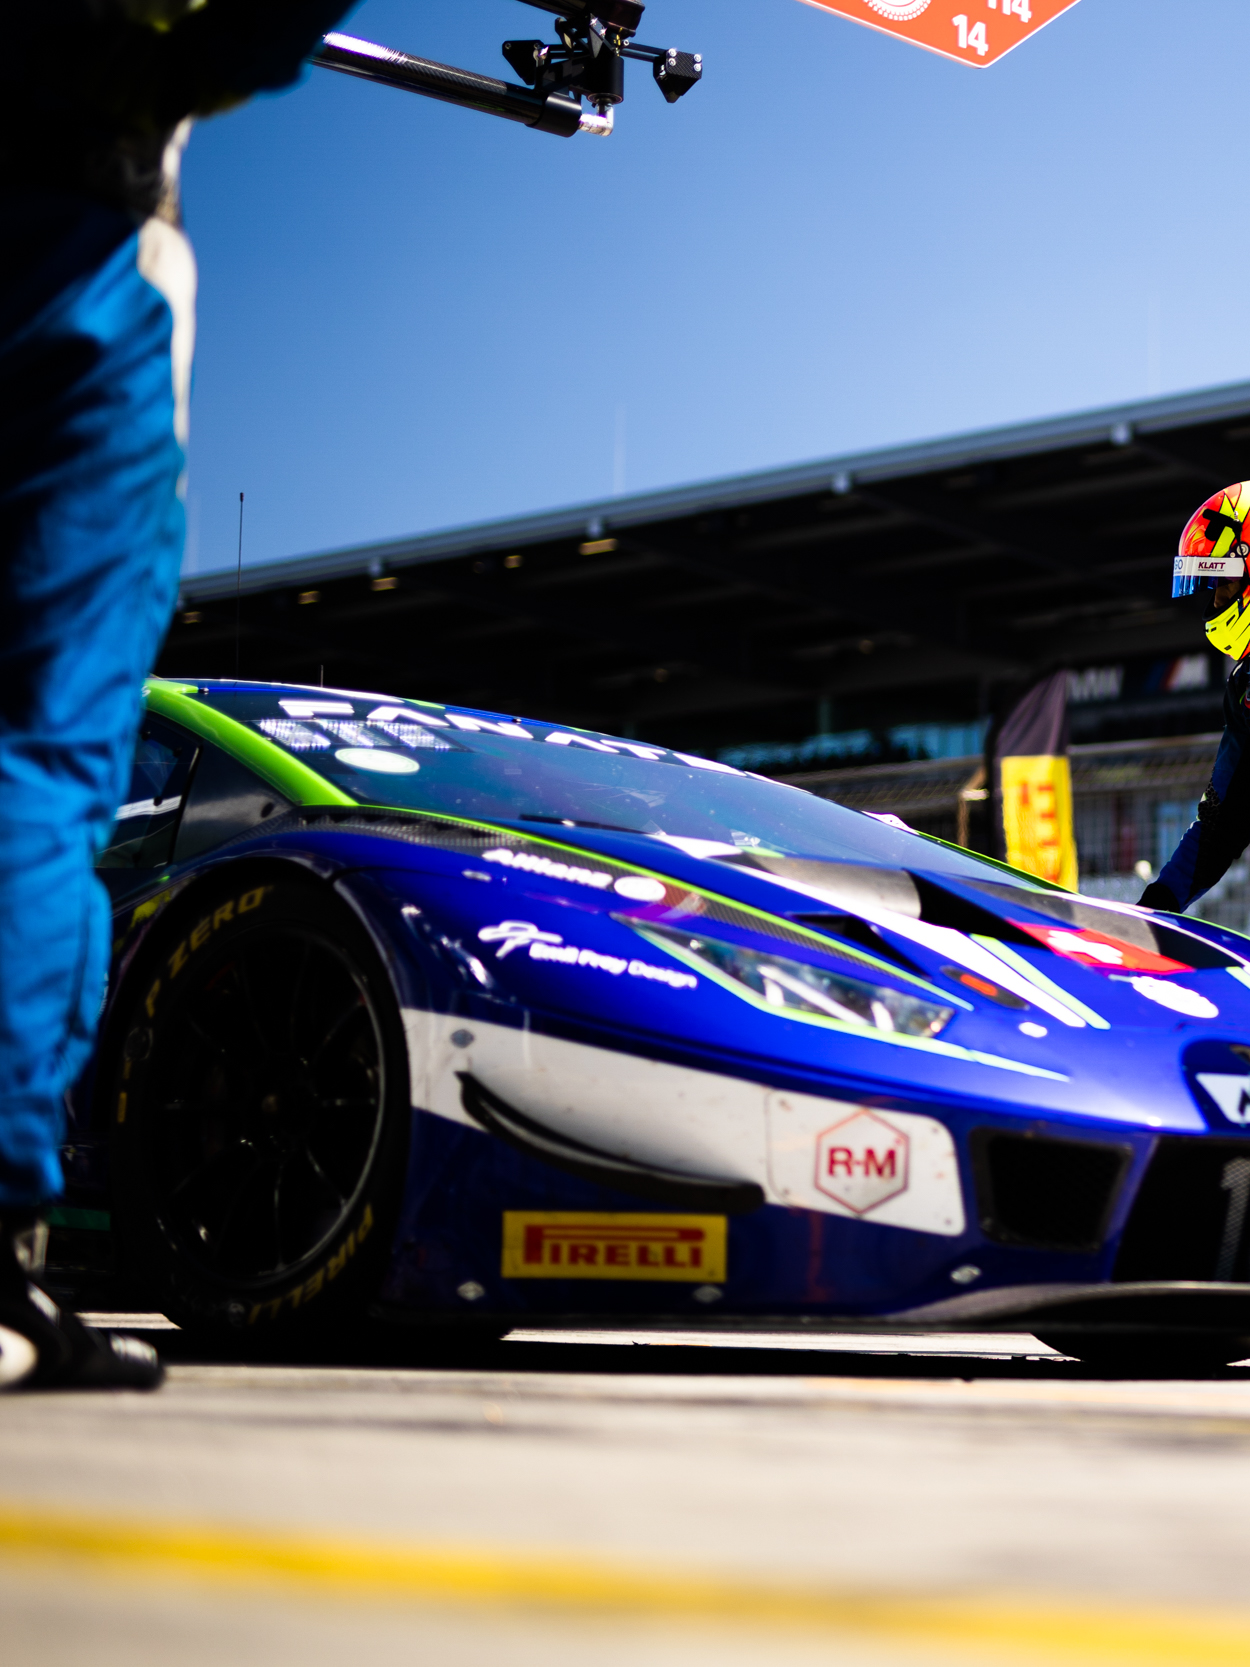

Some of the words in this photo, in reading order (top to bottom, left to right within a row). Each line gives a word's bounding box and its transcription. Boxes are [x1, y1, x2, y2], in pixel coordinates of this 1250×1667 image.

[952, 14, 989, 56] 14
[1198, 561, 1226, 569] KLATT
[166, 885, 265, 980] ZERO
[827, 1146, 897, 1177] R-M
[247, 1202, 375, 1326] PIRELLI
[524, 1224, 704, 1268] PIRELLI
